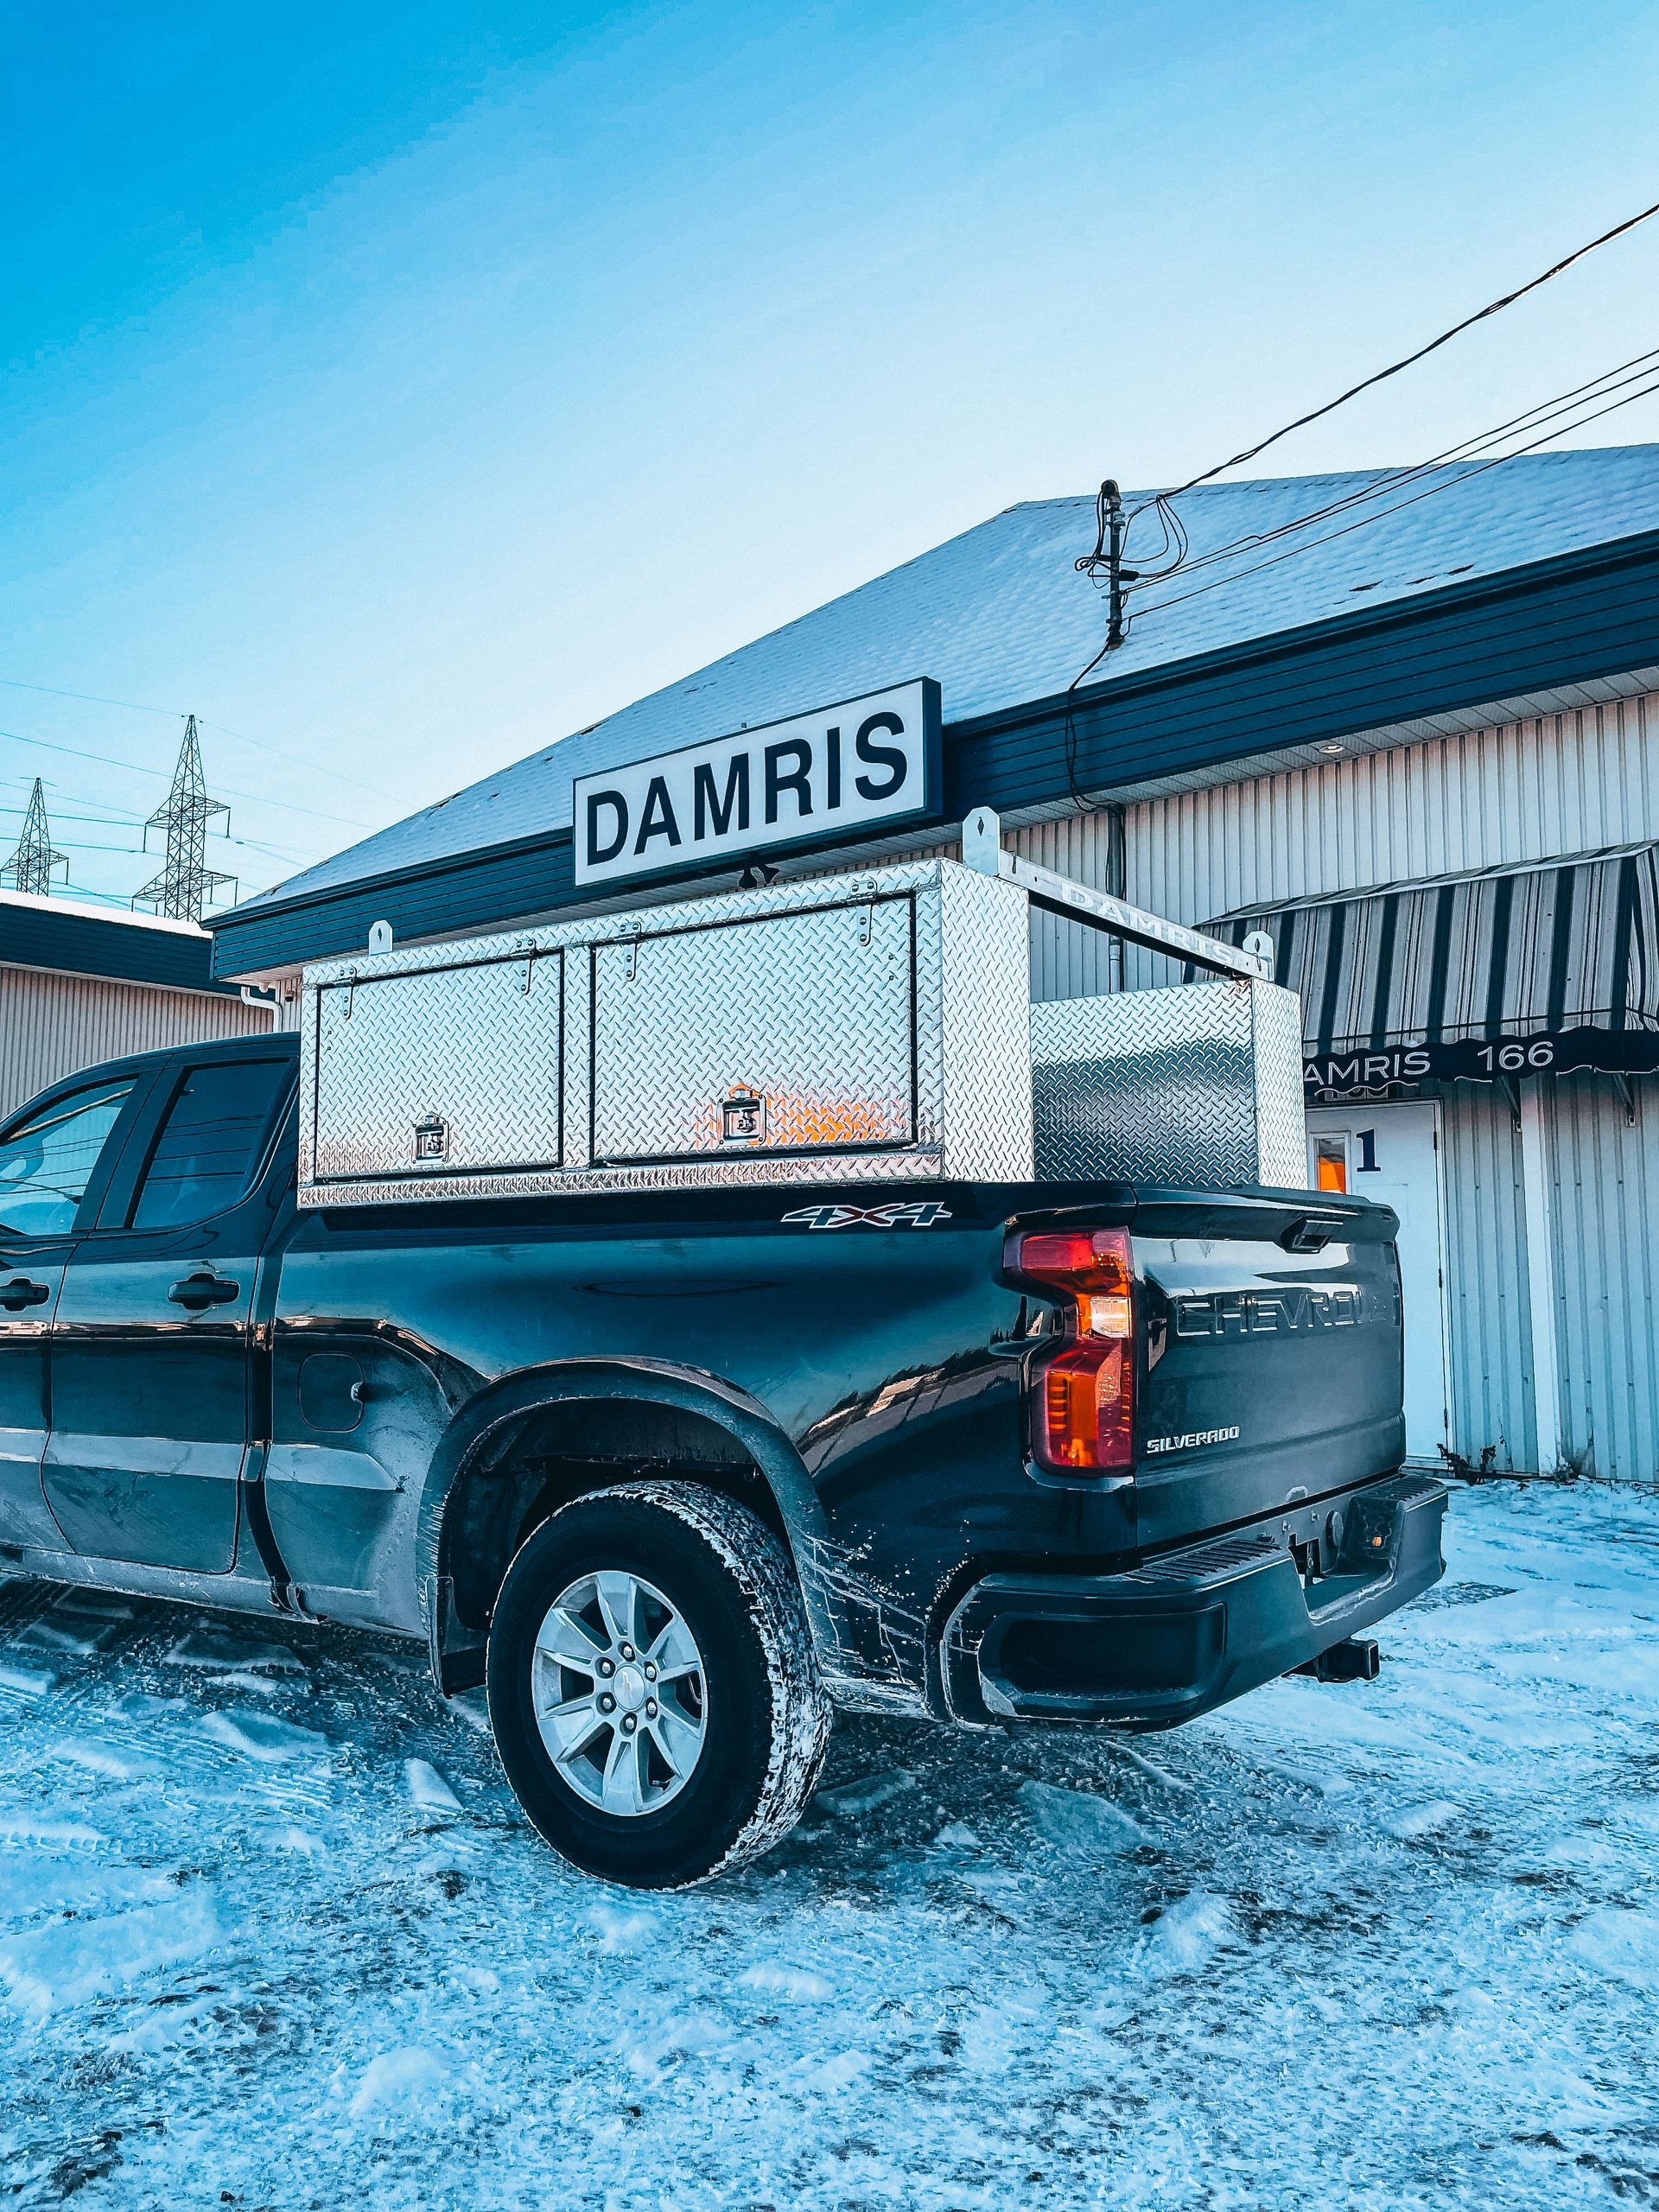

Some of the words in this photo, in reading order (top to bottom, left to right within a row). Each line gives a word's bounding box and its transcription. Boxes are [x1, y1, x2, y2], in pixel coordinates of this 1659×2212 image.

[587, 711, 908, 867] DAMRIS
[1061, 880, 1236, 965] DAMRIS
[1477, 1040, 1554, 1071] 166
[1356, 1128, 1382, 1173] 1
[780, 1202, 953, 1229] 4X4
[1147, 1426, 1241, 1454] SILVERADO
